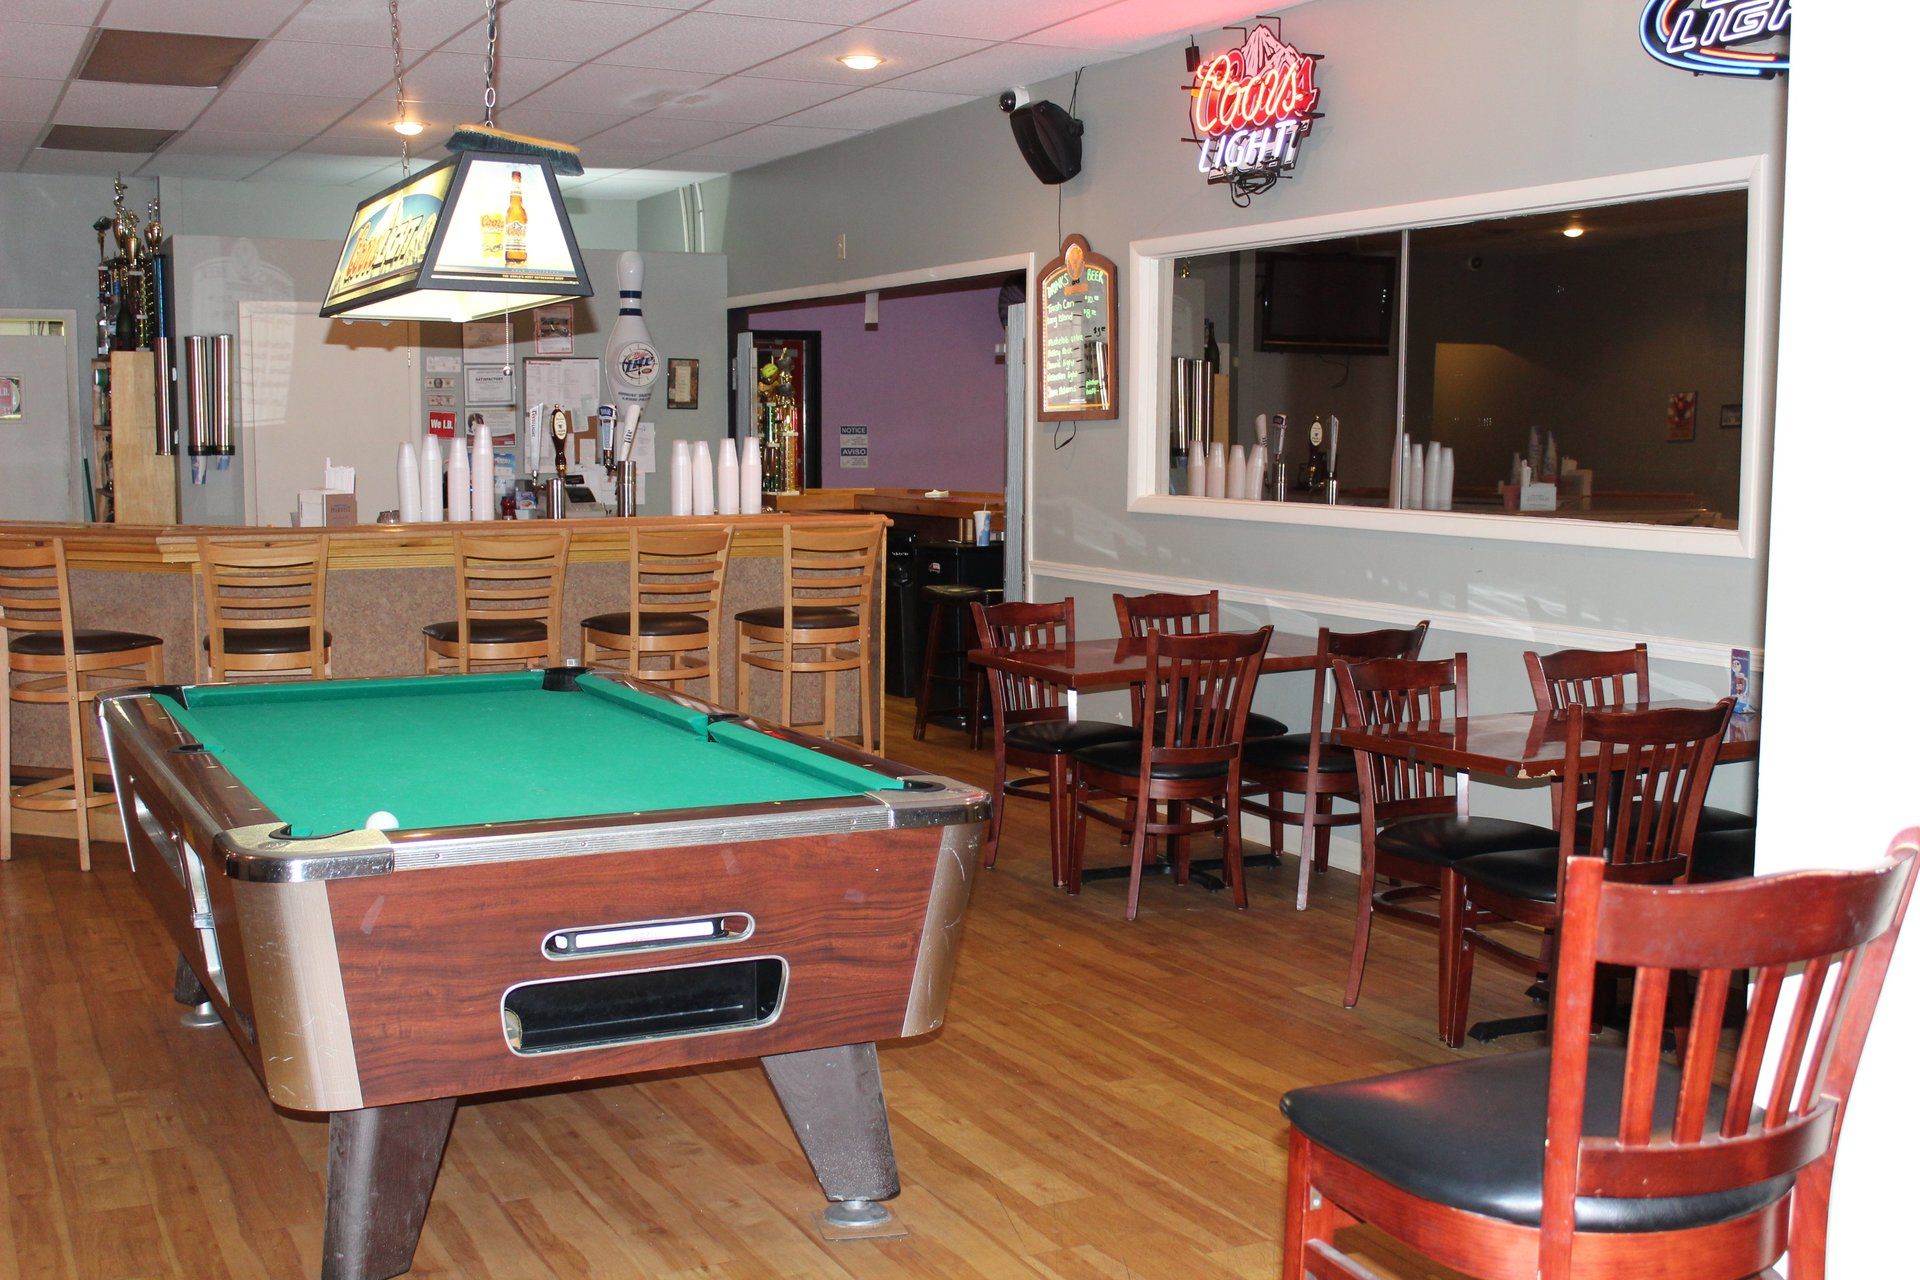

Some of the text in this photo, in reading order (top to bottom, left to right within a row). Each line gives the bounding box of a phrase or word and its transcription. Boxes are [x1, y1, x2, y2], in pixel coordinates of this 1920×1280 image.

[1196, 50, 1316, 136] Coors
[1198, 118, 1304, 176] LIGHT
[1047, 273, 1069, 298] DRINKS
[1087, 269, 1104, 284] BEER
[1063, 299, 1075, 309] Can
[431, 419, 454, 430] We I.D.
